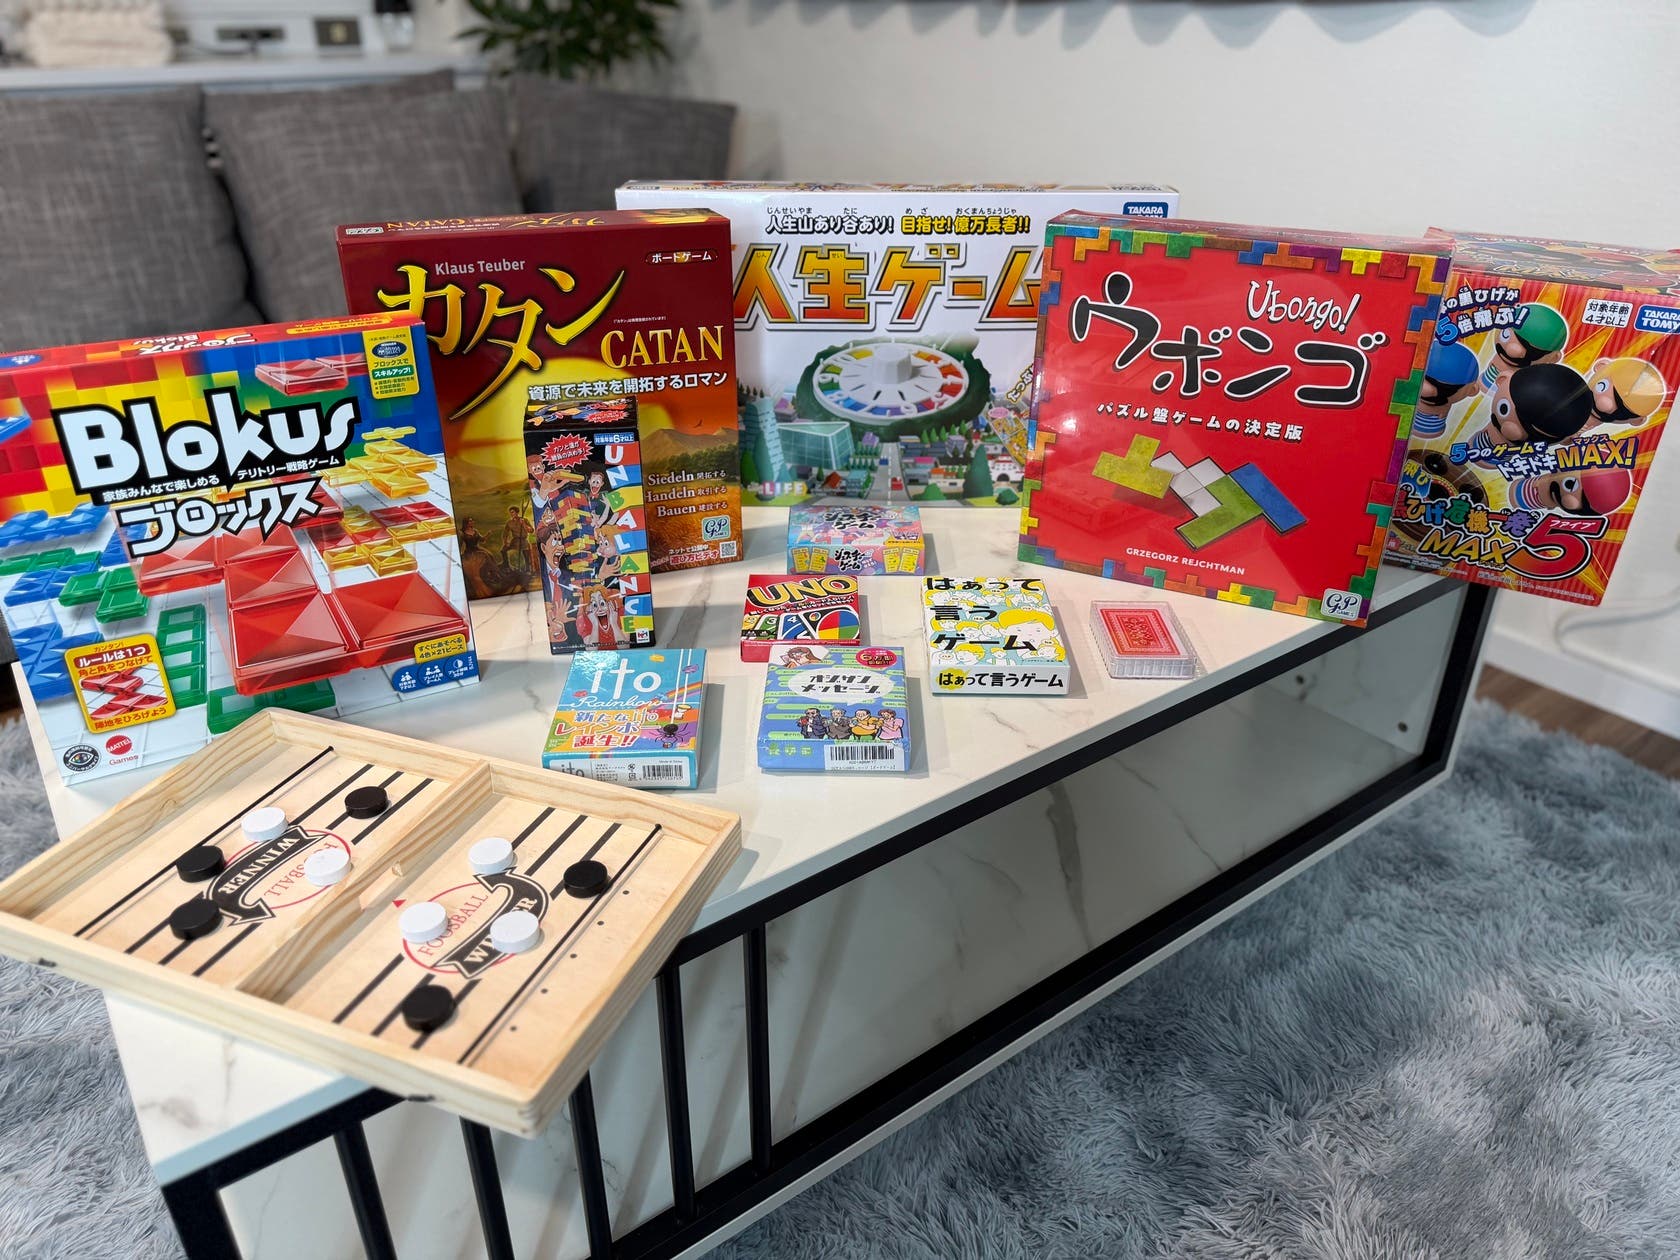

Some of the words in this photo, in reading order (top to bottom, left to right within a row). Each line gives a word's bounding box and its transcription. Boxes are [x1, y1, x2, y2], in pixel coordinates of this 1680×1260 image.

[1128, 206, 1163, 214] TAKARA
[766, 215, 894, 234] 人生山あり谷あり!
[652, 250, 712, 264] ボードゲーム
[435, 261, 475, 276] Klaus
[477, 258, 526, 273] Teuber
[733, 243, 1041, 325] 人生ゲーム
[1247, 280, 1361, 333] Ubongo!
[1588, 303, 1630, 314] 対象年齢
[1436, 307, 1530, 342] 5倍飛ぶ!
[1586, 315, 1626, 326] 4才以上
[1641, 317, 1680, 330] TOMY
[376, 263, 625, 421] カタン
[601, 325, 724, 369] CATAN
[1072, 271, 1388, 406] ウボンゴ
[374, 359, 409, 367] ブロックスで
[374, 367, 412, 378] スキルアップ!
[528, 371, 728, 402] 資源で未来を開拓するロマン
[1097, 401, 1305, 442] パズル盤ゲームの決定版
[57, 389, 357, 491] Blokus
[1574, 434, 1608, 446] マックス
[1451, 441, 1544, 464] 5つのゲームで
[102, 474, 220, 503] 家族みんなで楽しめる
[237, 454, 340, 481] テリトリー戦略ゲーム
[648, 470, 694, 486] Siedeln
[763, 481, 806, 496] LIFE
[118, 477, 324, 558] ブロックス
[657, 504, 696, 517] Bauen
[1549, 519, 1596, 529] ファイブ
[1418, 528, 1517, 565] MAX
[1507, 514, 1607, 577] 5
[1126, 547, 1179, 564] GRZEGORZ
[1181, 557, 1246, 576] REJCHTMAN
[747, 575, 859, 608] UNO
[926, 577, 1041, 591] はぁって
[1326, 593, 1358, 614] GP
[930, 605, 998, 621] 言う
[94, 641, 125, 653] カンタン!
[933, 633, 1038, 651] ゲーム
[78, 655, 153, 677] 角と角をつなげて
[79, 646, 147, 668] ルールは1つ
[591, 658, 662, 699] ito
[938, 672, 1064, 688] はぁって言うゲーム
[801, 684, 881, 694] メッセージ
[555, 720, 662, 735] レインボー
[107, 739, 131, 752] MATTEL
[109, 755, 139, 766] Games
[218, 838, 300, 895] WINNER
